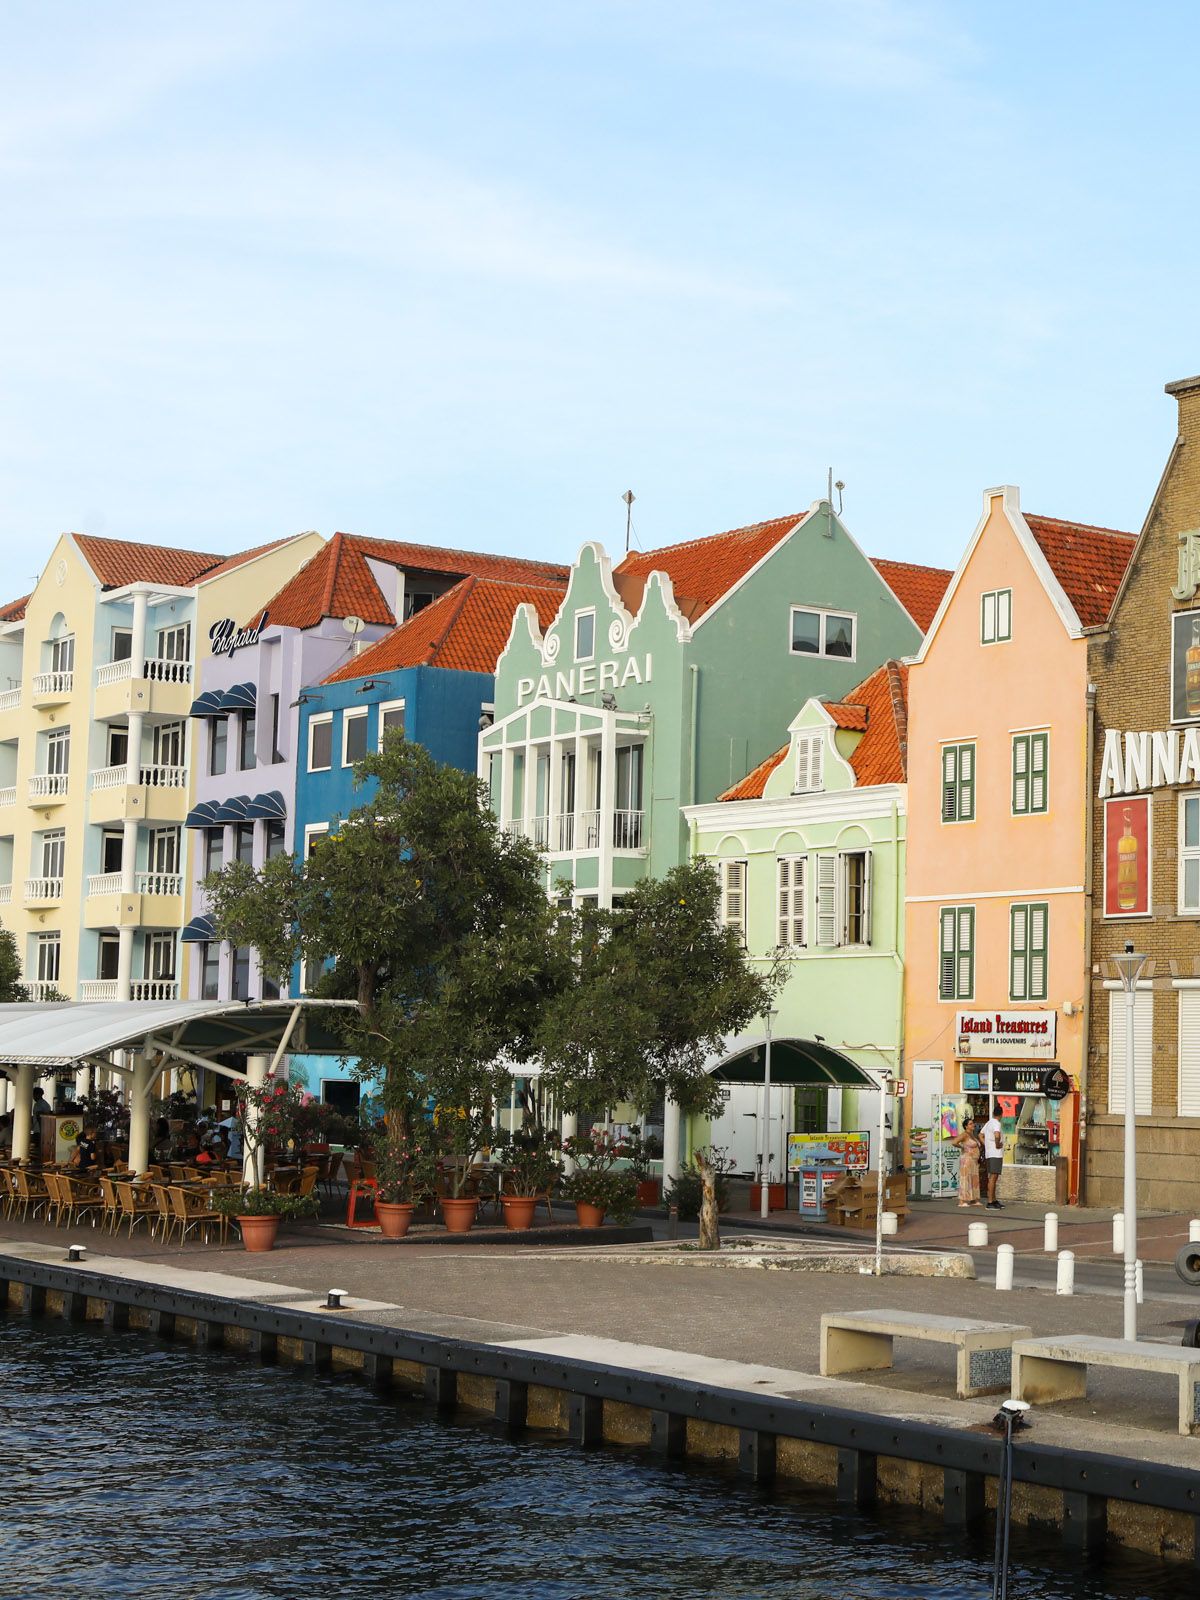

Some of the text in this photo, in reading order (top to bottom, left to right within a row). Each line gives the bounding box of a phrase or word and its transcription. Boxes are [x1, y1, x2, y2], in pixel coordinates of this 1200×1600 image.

[209, 610, 270, 658] Chopard
[517, 653, 652, 707] PANERAI
[961, 1014, 1048, 1034] Island Treasures
[897, 1081, 905, 1094] B
